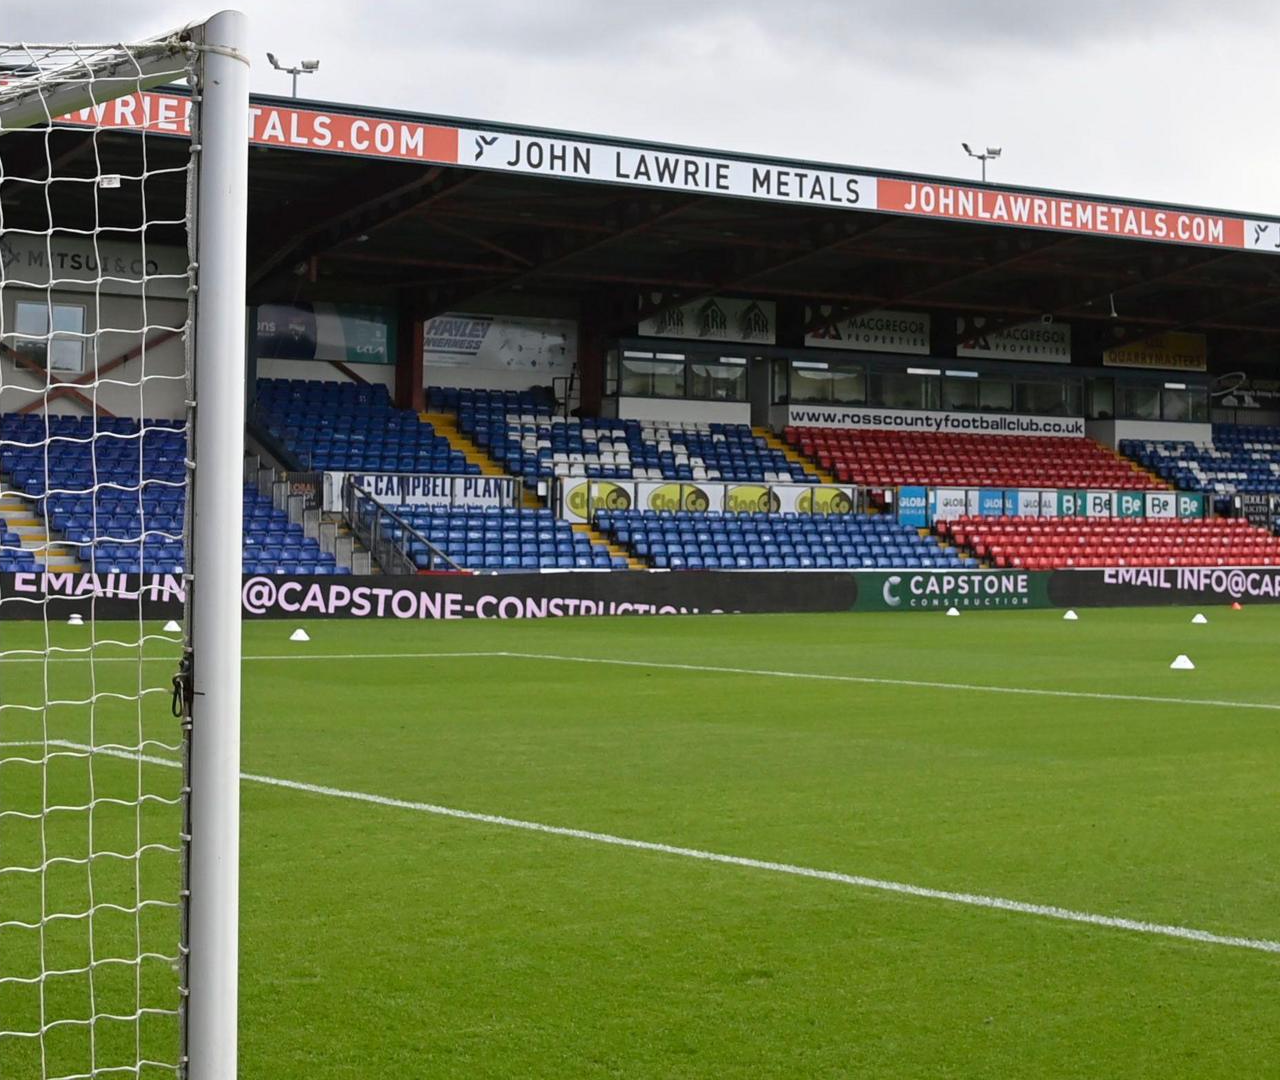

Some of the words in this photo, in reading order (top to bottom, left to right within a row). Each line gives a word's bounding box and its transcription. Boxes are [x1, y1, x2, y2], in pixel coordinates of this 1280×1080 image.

[506, 139, 591, 175] JOHN
[615, 151, 731, 191] LAWRIE
[751, 167, 860, 204] METALS
[903, 183, 1224, 244] JOHNLAWRIEMETALS.COM
[847, 317, 925, 334] MACGREGOR
[790, 409, 1084, 435] www.rosscountyfootballclub.co.uk
[910, 574, 1029, 595] CAPSTONE
[1103, 567, 1172, 589] EMAIL
[910, 597, 1030, 607] CONSTRUCTION
